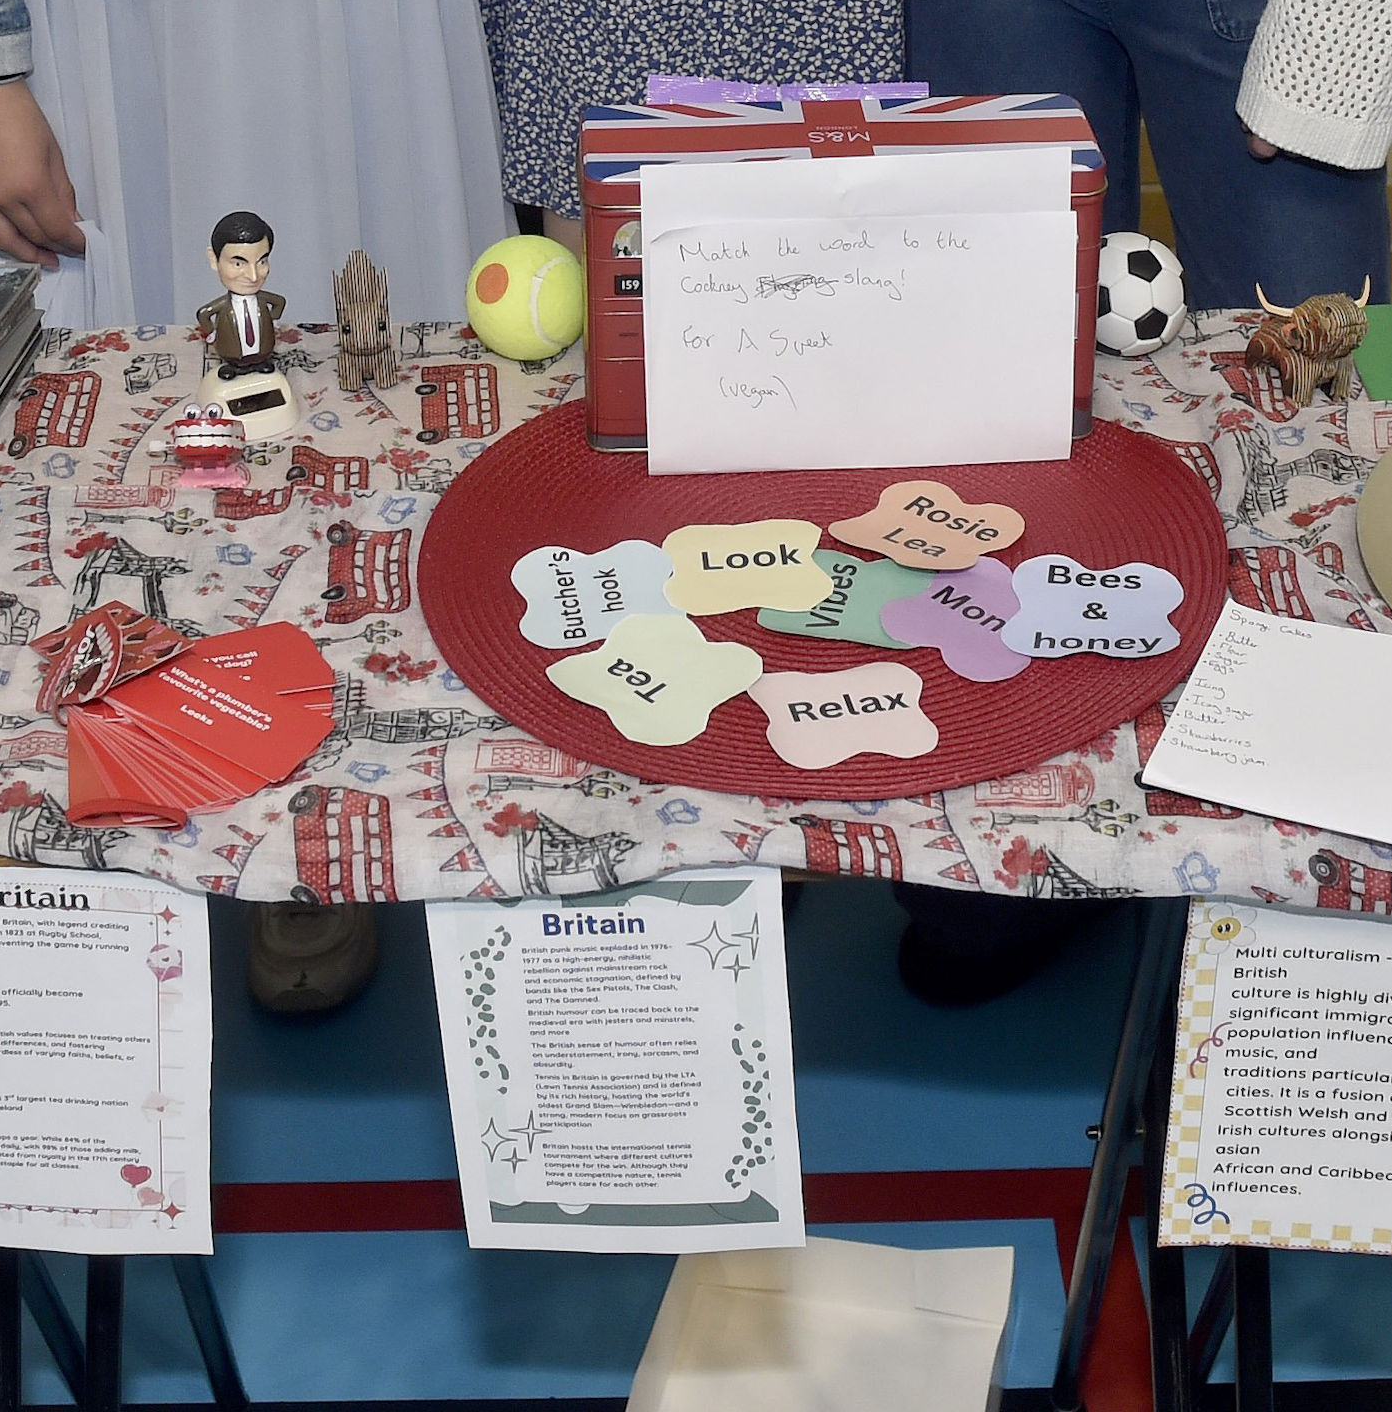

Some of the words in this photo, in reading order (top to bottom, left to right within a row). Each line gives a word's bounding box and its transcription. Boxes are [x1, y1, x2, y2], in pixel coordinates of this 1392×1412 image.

[808, 131, 870, 143] M&S
[679, 240, 750, 263] Match
[778, 237, 800, 257] the
[818, 229, 875, 252] word
[903, 228, 920, 249] to
[936, 230, 970, 250] the
[620, 279, 639, 291] 159
[680, 272, 749, 305] Cockney
[843, 267, 905, 301] slang!
[682, 324, 712, 350] For
[737, 327, 759, 354] A
[719, 374, 797, 410] (vegan)
[902, 495, 999, 542] Rosie
[881, 527, 947, 558] Lea
[701, 543, 802, 571] Look
[600, 566, 623, 612] hook
[1047, 564, 1142, 590] Bees
[552, 551, 587, 640] Butcher's
[805, 563, 857, 628] Vibes
[931, 586, 1006, 632] Mon
[1082, 602, 1108, 621] &
[1033, 631, 1163, 654] honey
[1225, 631, 1259, 648] Butter
[1280, 625, 1312, 638] Cakes
[1220, 643, 1247, 657] Flour
[606, 657, 667, 704] Tea
[1209, 661, 1234, 675] Eggs
[159, 672, 208, 701] favourite
[210, 698, 270, 731] vegetable?
[171, 667, 207, 689] What's
[215, 692, 272, 722] plumber's
[787, 692, 910, 723] Relax
[1184, 710, 1226, 724] Butter
[3, 919, 34, 927] Britain,
[58, 921, 88, 929] legend
[90, 922, 129, 931] crediting
[541, 911, 645, 937] Britain
[1235, 946, 1277, 959] Multi
[1282, 947, 1380, 963] culturalism
[1233, 966, 1288, 979] British
[1231, 987, 1292, 999] culture
[1297, 987, 1310, 1000] is
[1315, 988, 1368, 1005] highly
[1228, 1006, 1320, 1021] significant
[1227, 1026, 1321, 1041] population
[1225, 1048, 1278, 1061] music,
[1284, 1047, 1318, 1060] and
